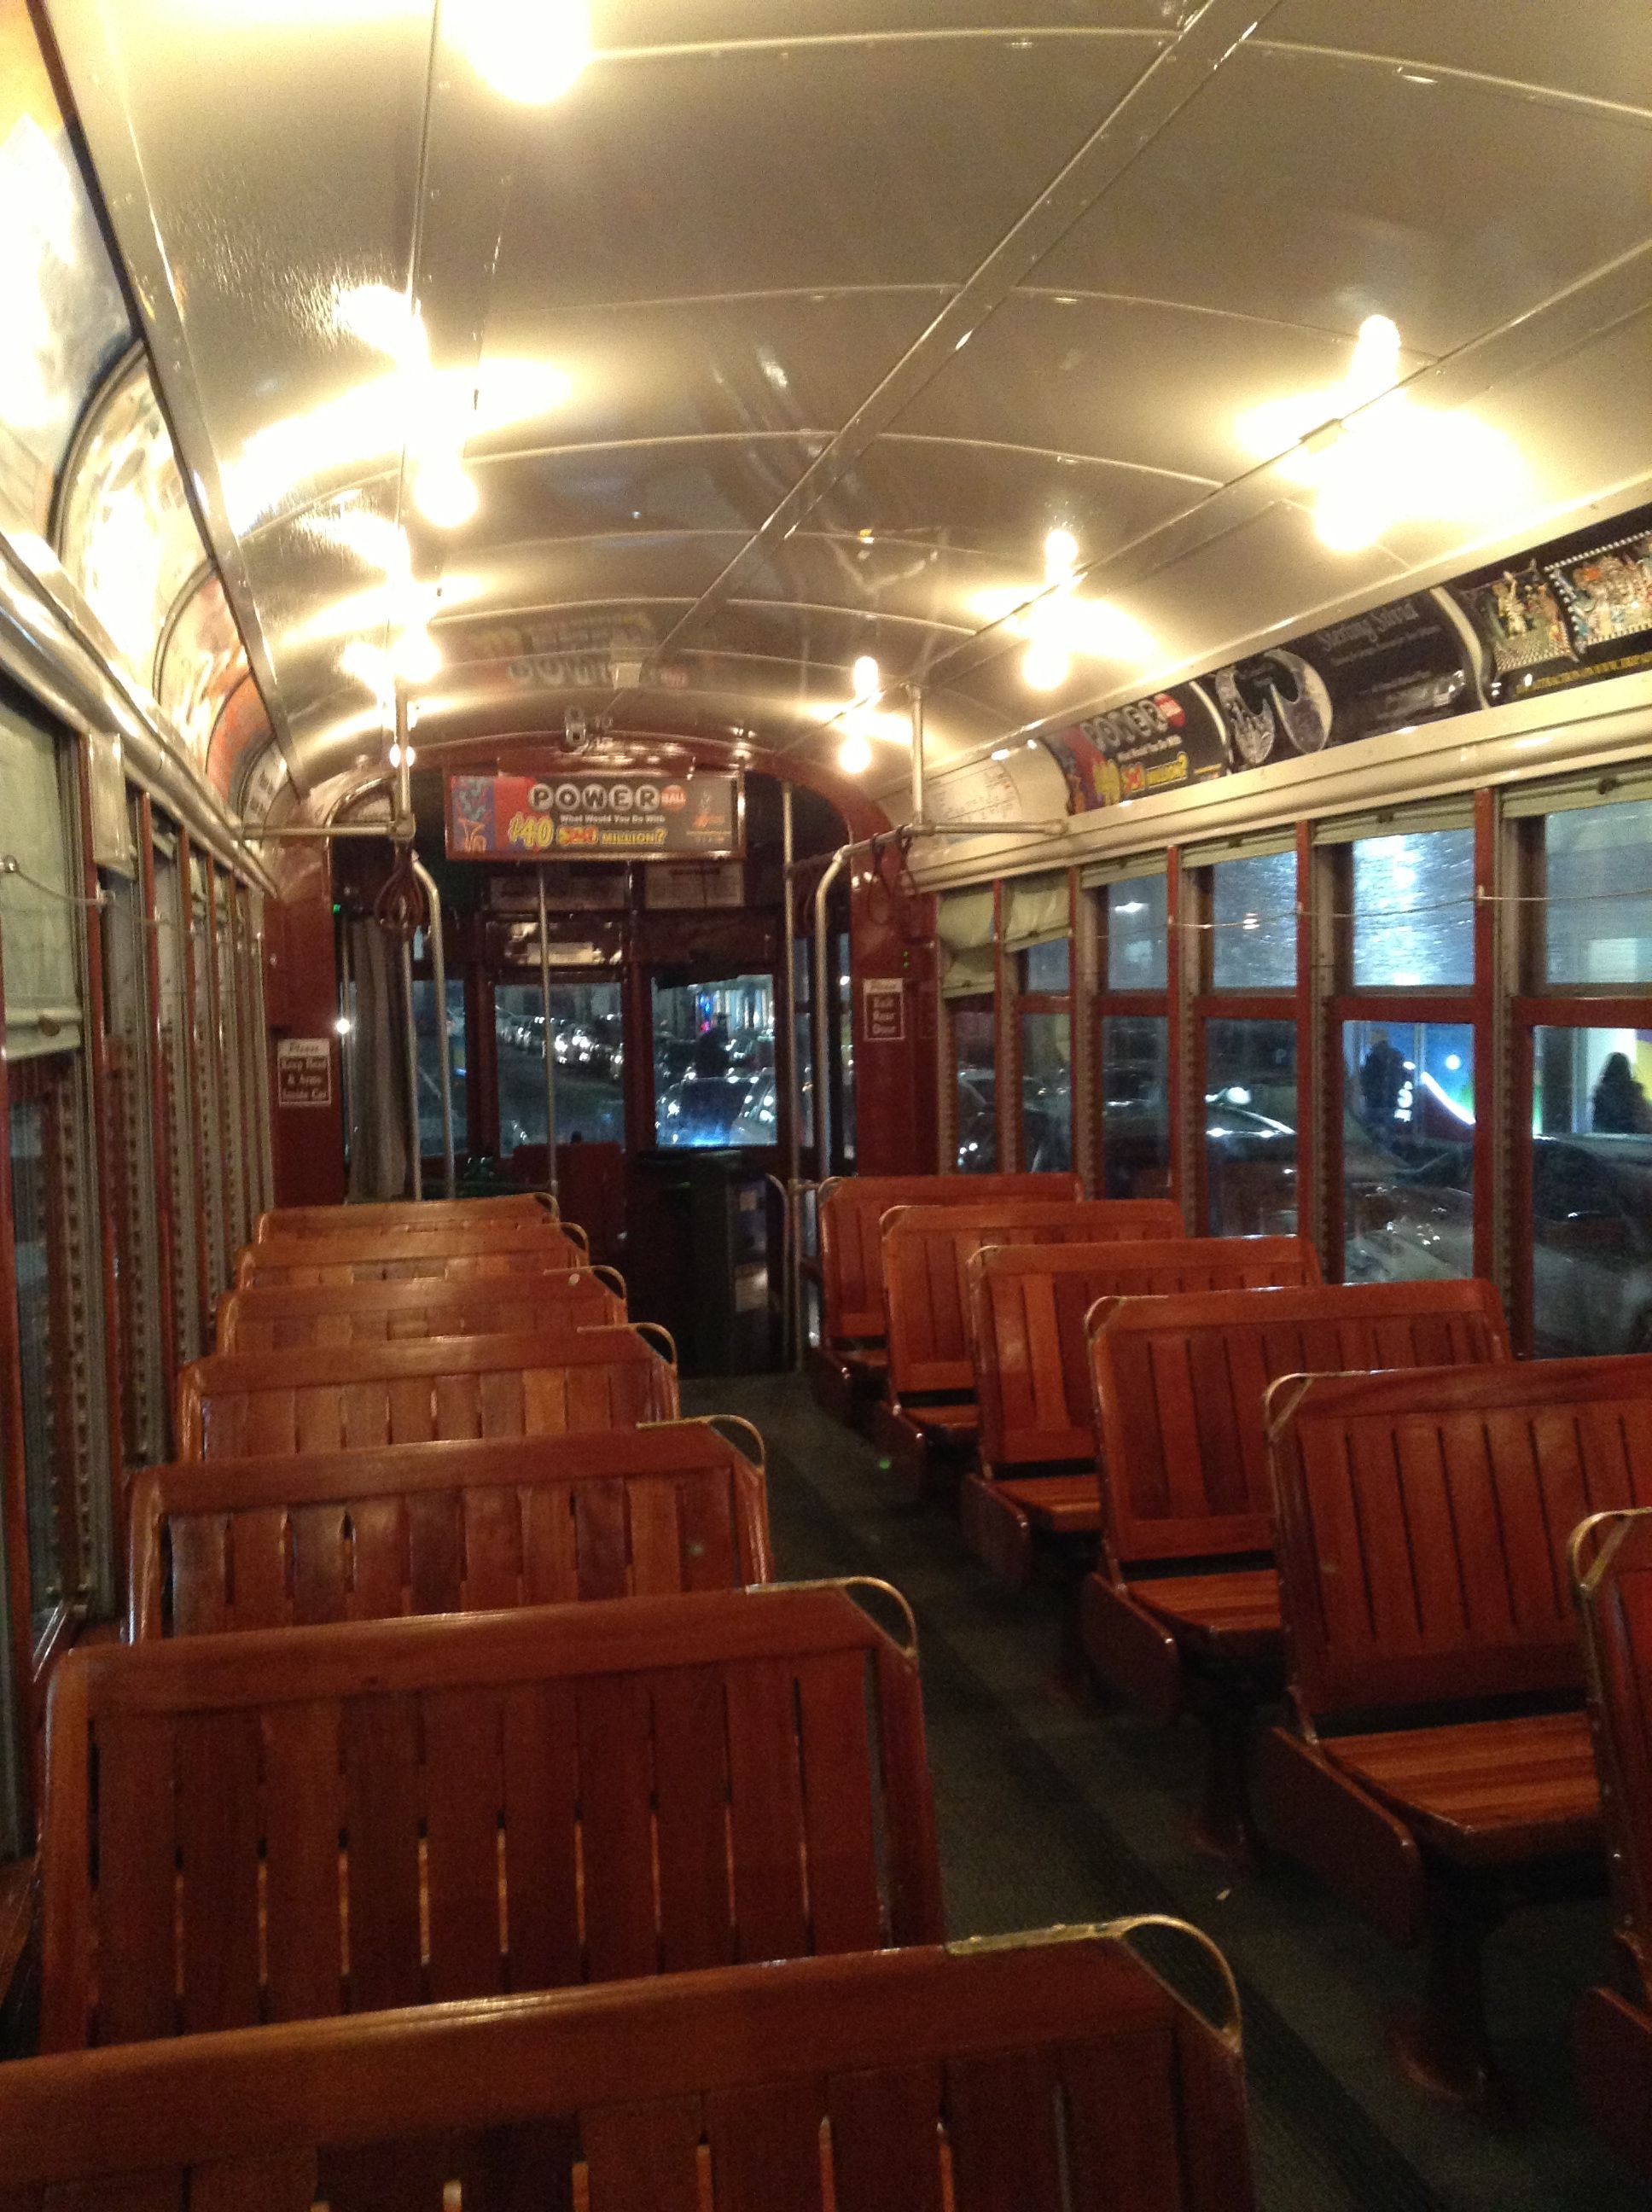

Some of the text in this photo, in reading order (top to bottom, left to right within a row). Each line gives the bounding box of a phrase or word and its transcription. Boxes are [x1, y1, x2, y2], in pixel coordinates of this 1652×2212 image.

[530, 785, 660, 810] POWER
[560, 813, 666, 824] What Would You Do With
[601, 826, 667, 845] MILLION?
